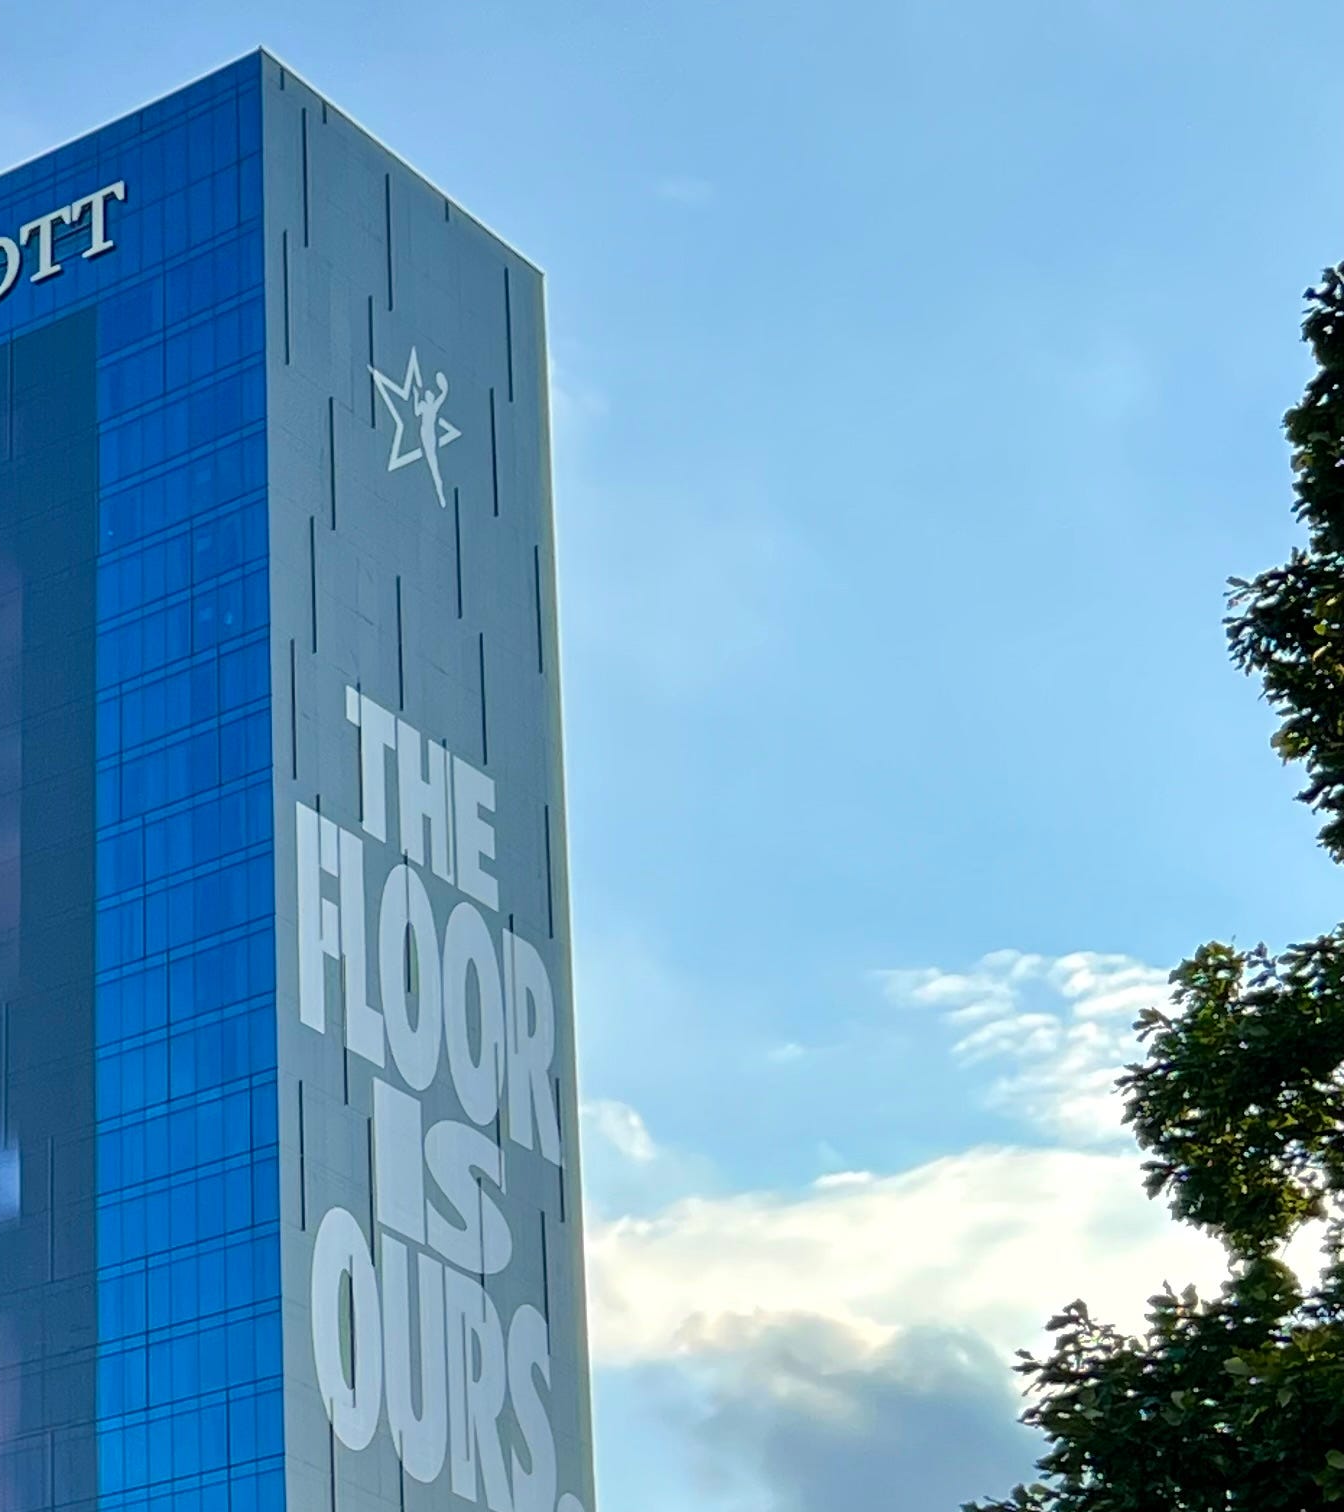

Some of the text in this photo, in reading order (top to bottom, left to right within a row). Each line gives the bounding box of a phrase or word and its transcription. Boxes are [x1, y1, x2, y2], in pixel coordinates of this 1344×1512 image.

[345, 685, 499, 912] THE
[296, 801, 563, 1168] FLOOR
[373, 1076, 512, 1275] IS
